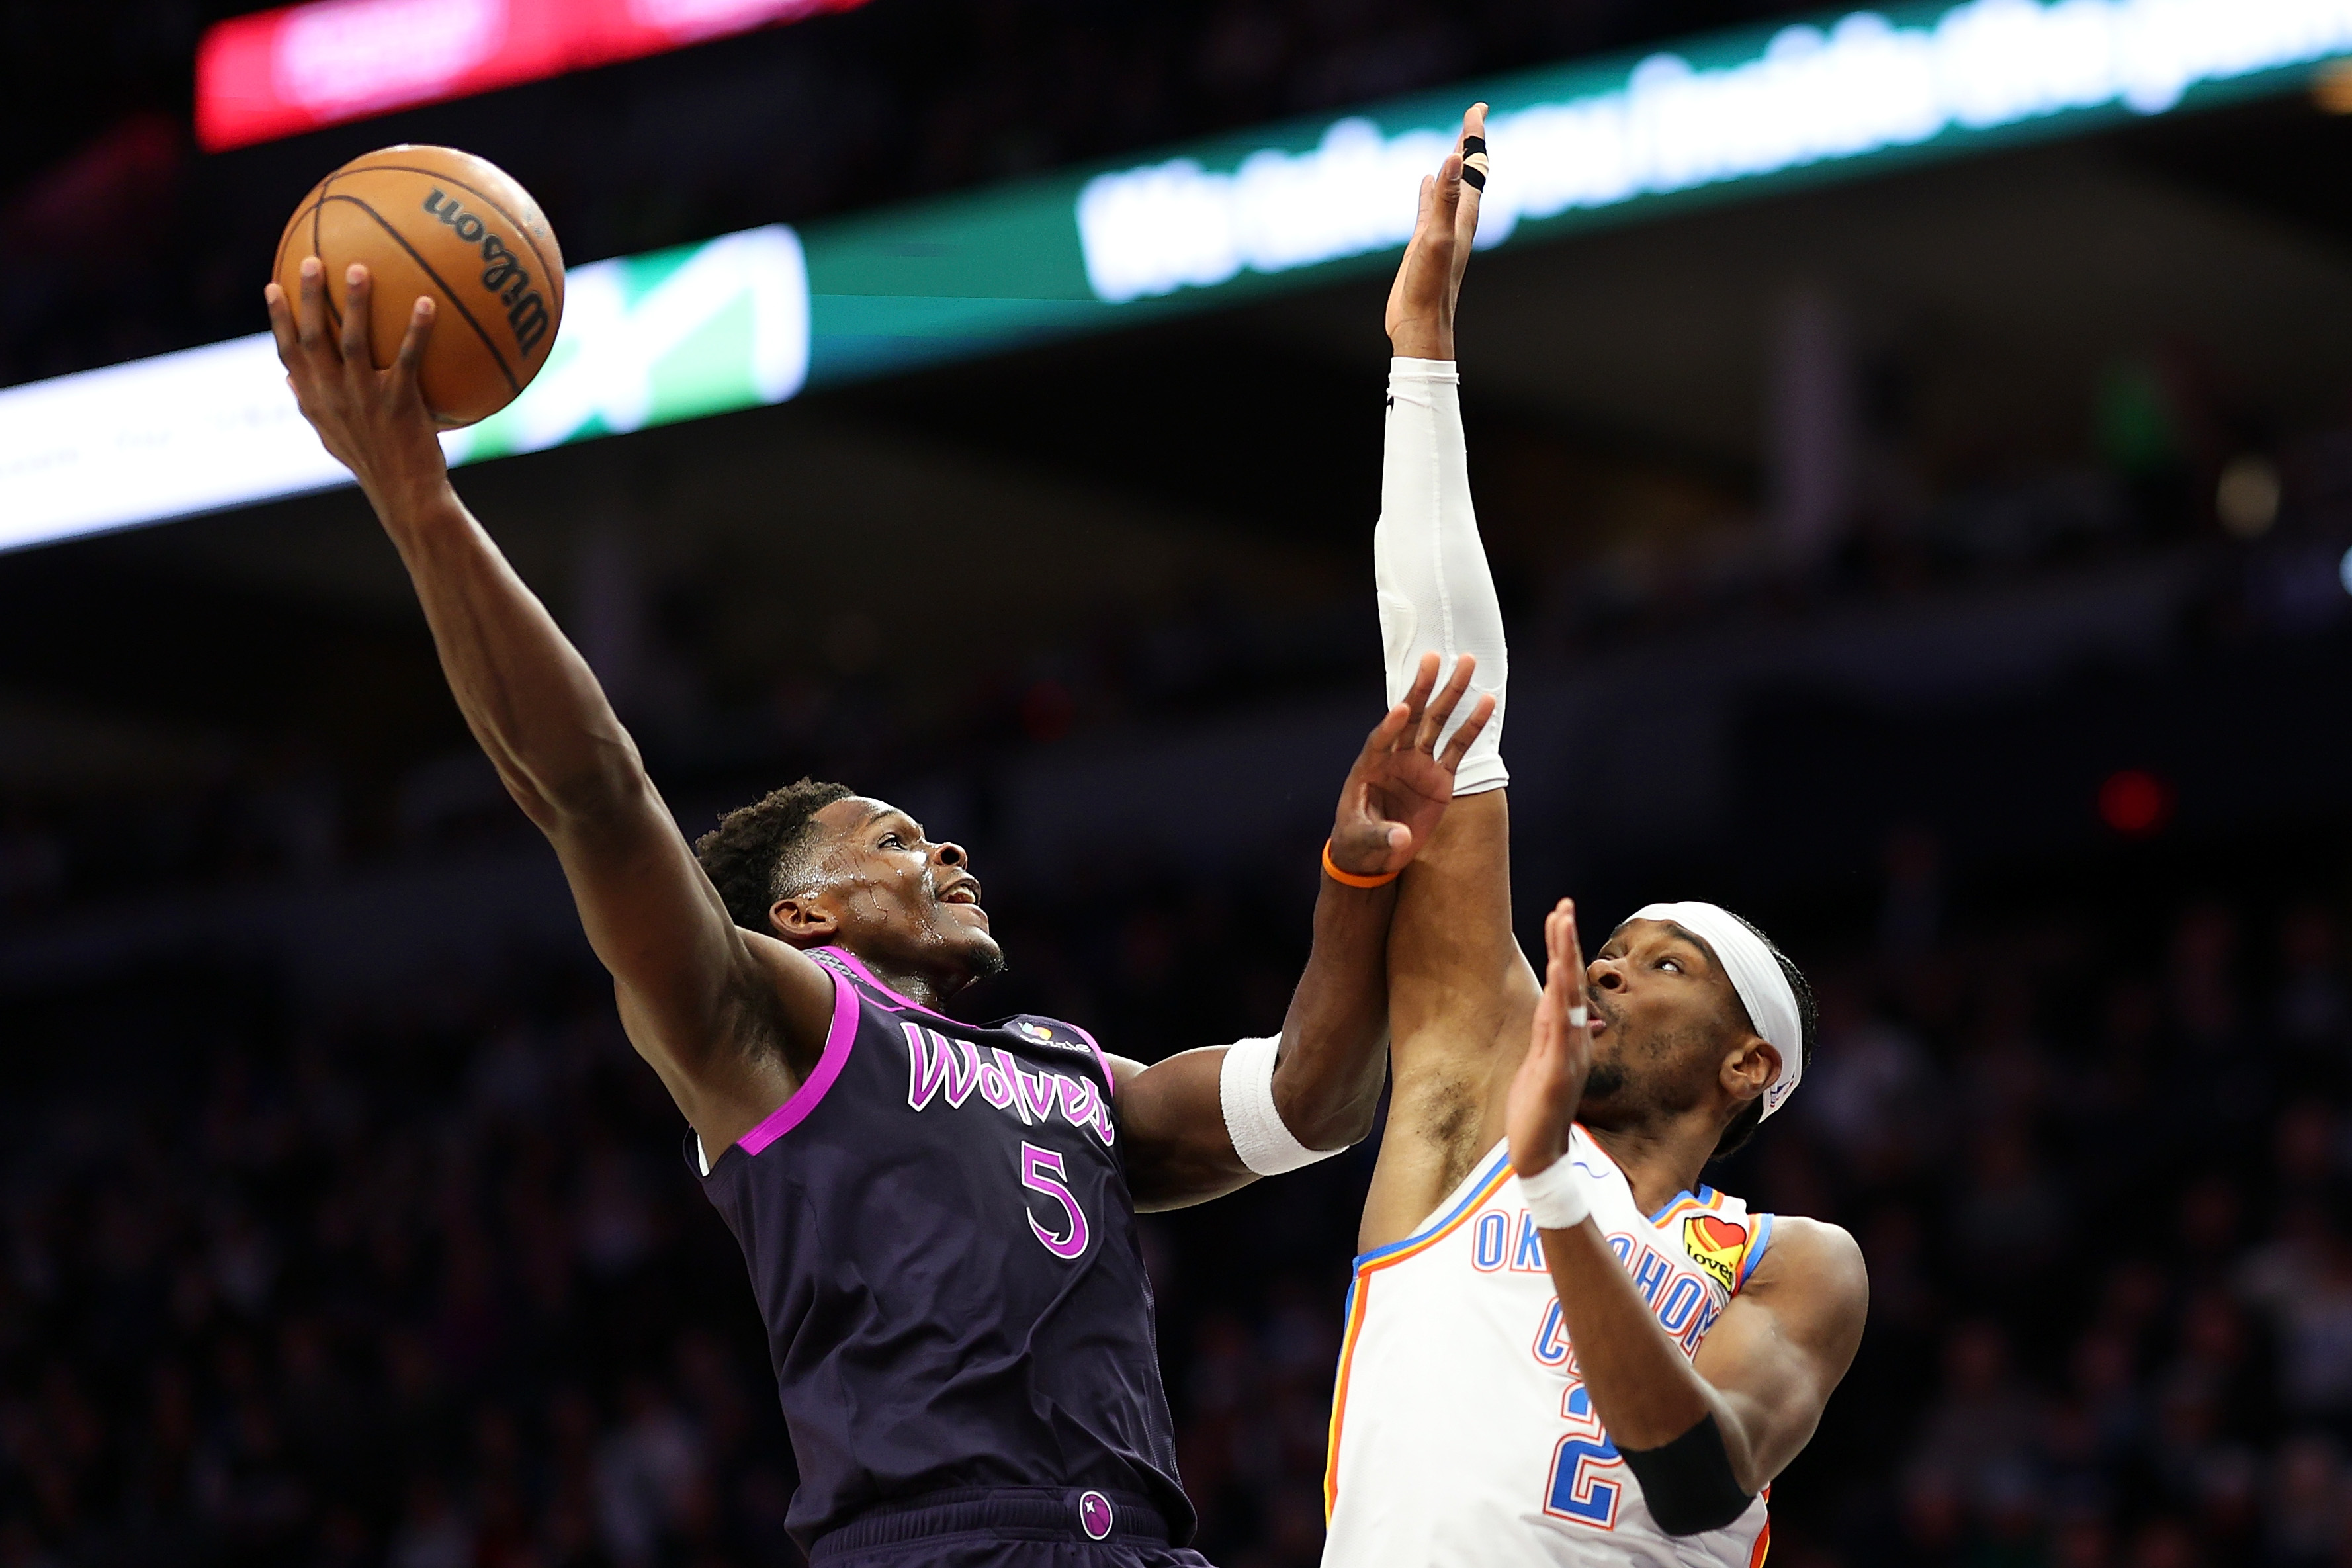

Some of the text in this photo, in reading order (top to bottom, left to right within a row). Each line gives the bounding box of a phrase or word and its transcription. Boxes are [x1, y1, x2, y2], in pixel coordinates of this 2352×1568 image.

[422, 187, 549, 358] Wilson
[900, 1022, 1115, 1147] Wolves
[1021, 1141, 1090, 1259] 5
[1543, 1380, 1625, 1531] 2
